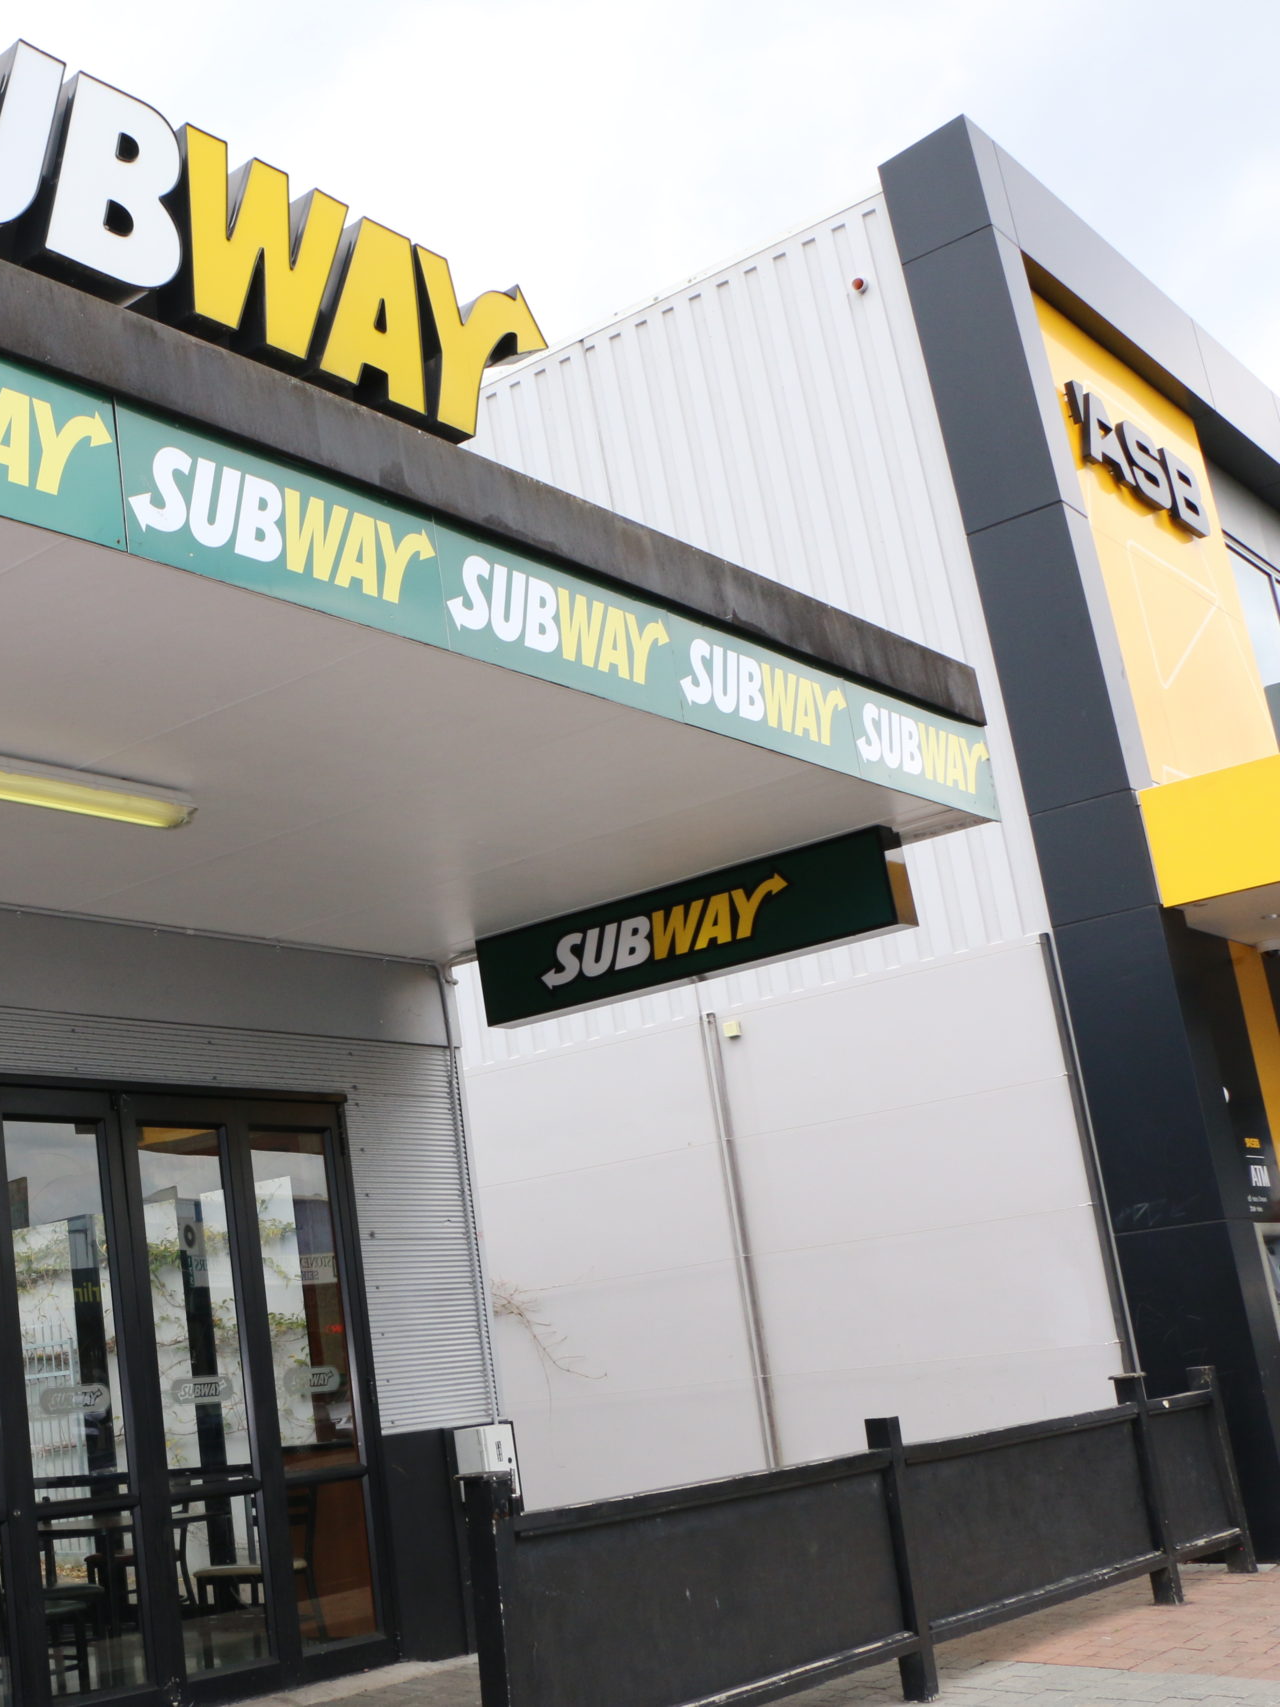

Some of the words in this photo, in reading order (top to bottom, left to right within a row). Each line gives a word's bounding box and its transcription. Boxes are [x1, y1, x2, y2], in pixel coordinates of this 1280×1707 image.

[1064, 380, 1211, 539] ASB
[128, 446, 436, 604] SUBWAY
[446, 555, 670, 686] SUBWAY
[679, 638, 847, 746] SUBWAY
[856, 702, 990, 795] SUBWAY
[540, 871, 789, 990] SUBWAY
[1250, 1165, 1271, 1187] ATM
[48, 1389, 103, 1413] SUWAY
[178, 1379, 228, 1401] SUBWAY
